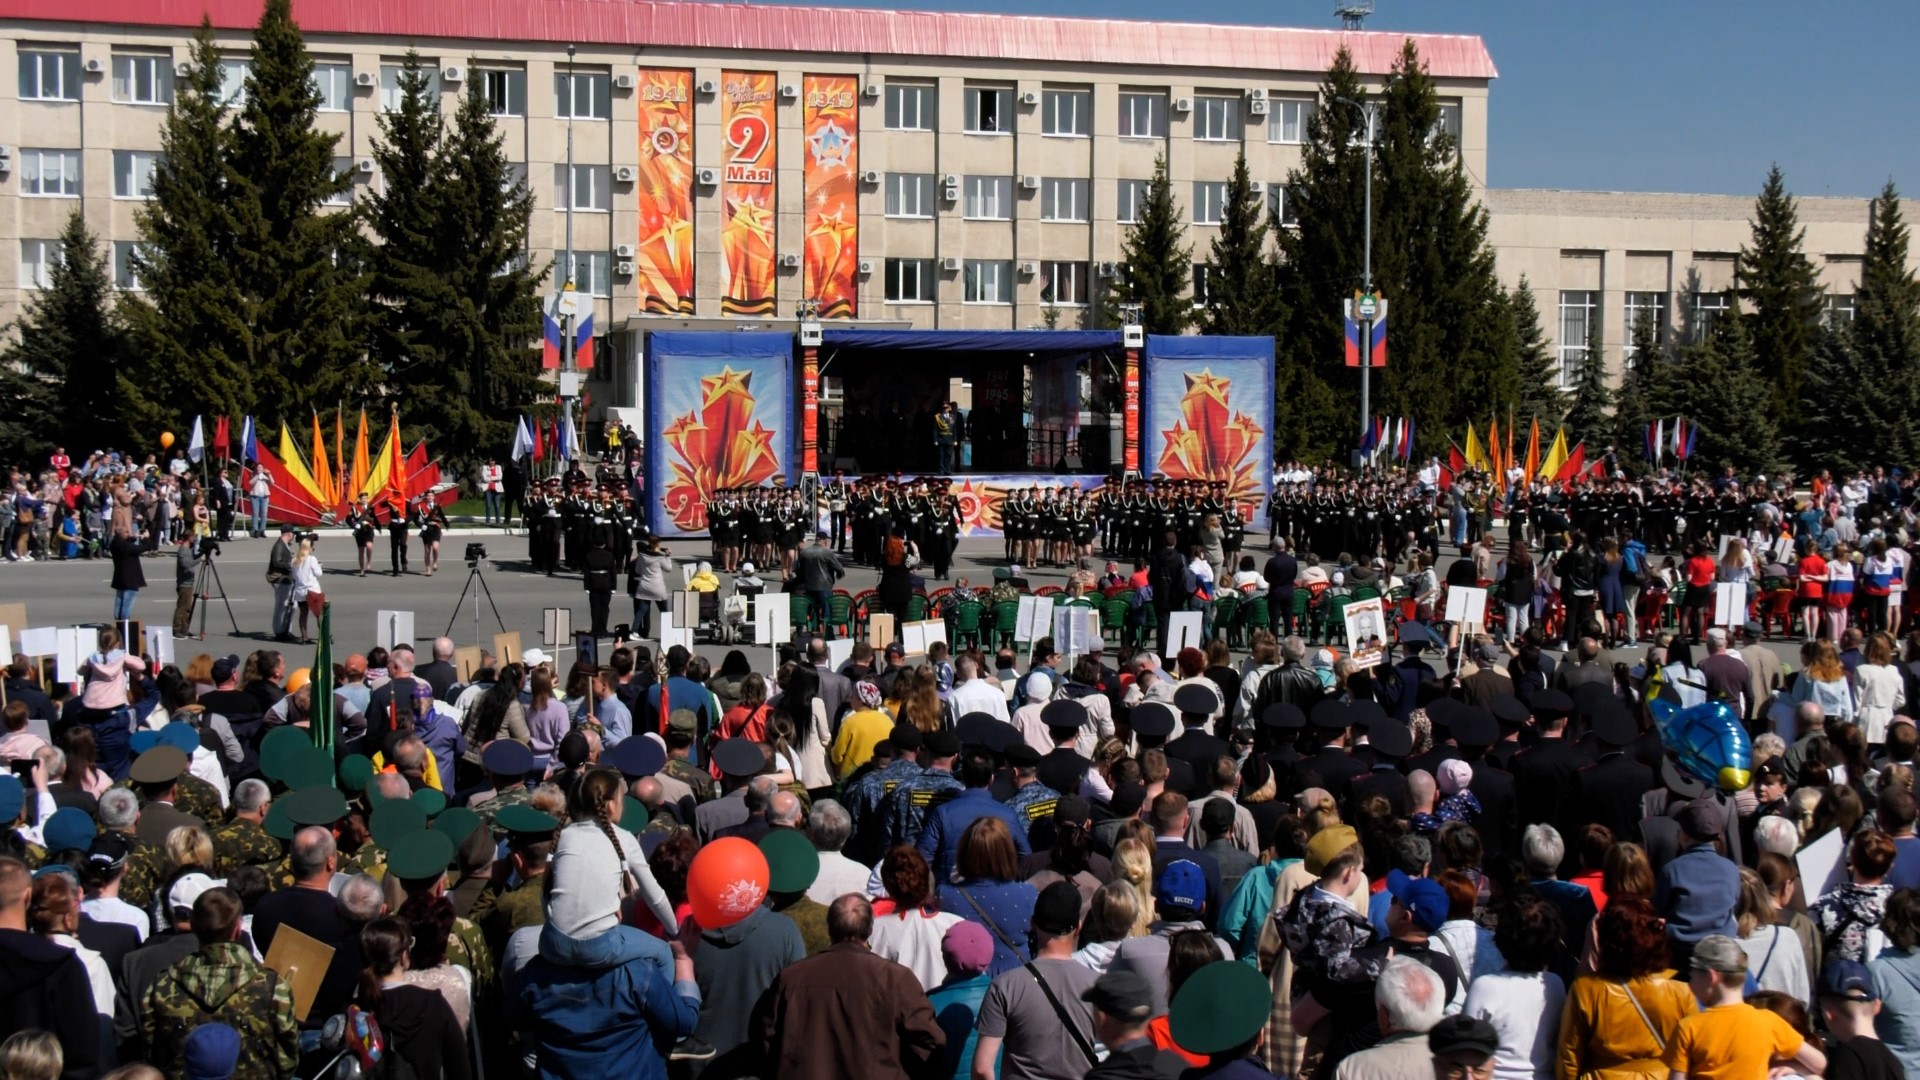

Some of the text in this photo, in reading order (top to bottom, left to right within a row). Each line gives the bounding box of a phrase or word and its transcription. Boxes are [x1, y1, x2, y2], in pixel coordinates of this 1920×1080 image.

[643, 85, 687, 101] 1941
[807, 92, 853, 108] 1945
[727, 115, 769, 162] 9
[726, 165, 771, 182] Мая
